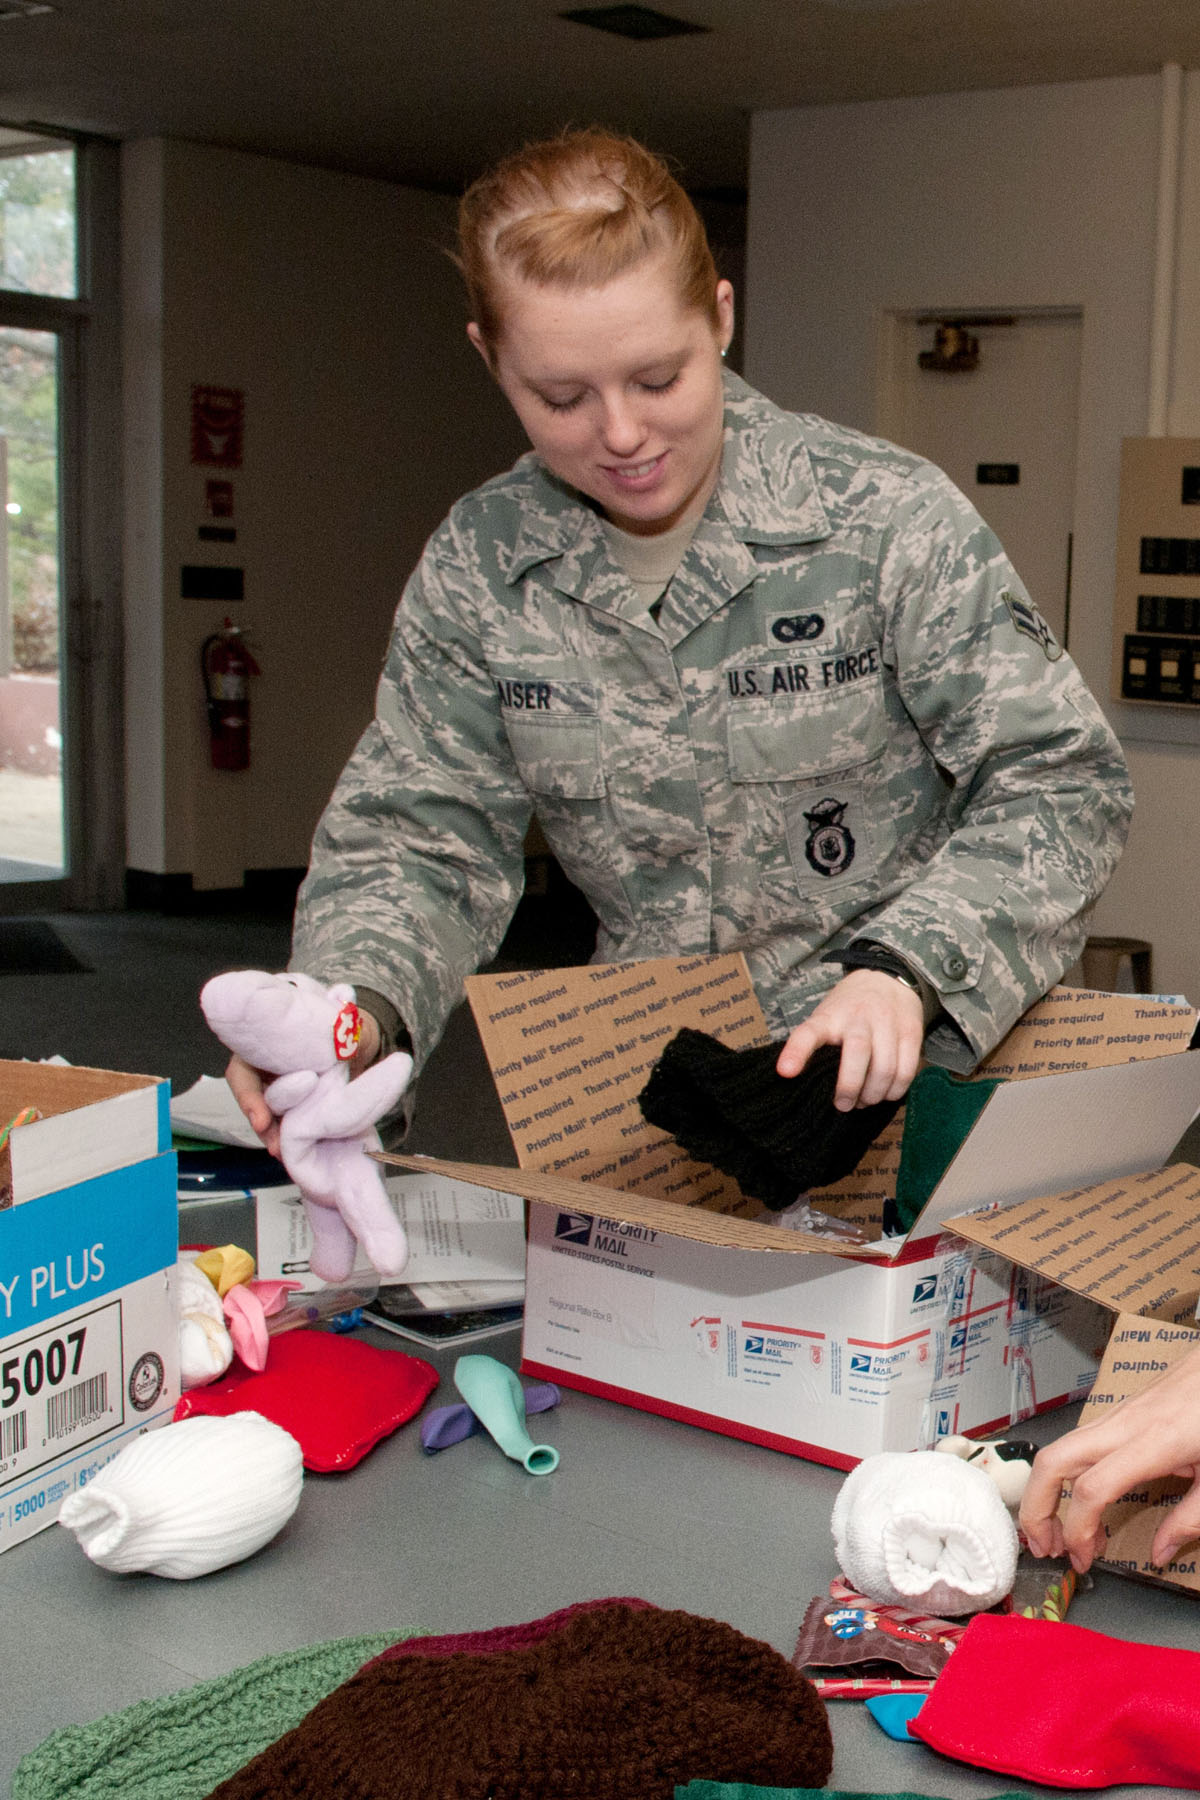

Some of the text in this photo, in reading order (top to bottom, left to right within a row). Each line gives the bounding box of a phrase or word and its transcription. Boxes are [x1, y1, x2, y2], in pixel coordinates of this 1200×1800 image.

[728, 648, 879, 697] U.S. AIR FORCE
[589, 962, 636, 983] Thank you
[676, 956, 704, 975] Thank
[496, 974, 527, 991] Thank
[488, 985, 569, 1024] postage required
[521, 1017, 557, 1038] Priority
[583, 994, 619, 1015] postage
[619, 976, 657, 998] required
[613, 1008, 647, 1028] Priority
[672, 985, 705, 1005] postage
[705, 969, 740, 990] required
[1076, 991, 1096, 1002] you
[700, 1001, 731, 1018] Priority
[1058, 1012, 1105, 1026] required
[1134, 1008, 1192, 1020] Thank you
[724, 1015, 755, 1033] Service
[1033, 1037, 1073, 1049] Priority
[1106, 1033, 1151, 1046] postage
[493, 1061, 523, 1080] riority
[549, 1034, 585, 1055] Service
[519, 1083, 539, 1099] you
[539, 1075, 554, 1090] for
[555, 1065, 582, 1082] using
[581, 1051, 616, 1070] Priority
[640, 1025, 673, 1044] Service
[976, 1063, 1015, 1076] Priority
[1047, 1060, 1088, 1071] Service
[583, 1064, 645, 1097] Thank you for
[534, 1096, 575, 1121] required
[526, 1132, 564, 1154] Priority
[590, 1102, 625, 1125] postage
[553, 1148, 591, 1172] Service
[581, 1162, 618, 1183] Priority
[643, 1164, 669, 1181] using
[664, 1169, 712, 1195] Thank you
[856, 1166, 889, 1178] you for
[808, 1190, 886, 1204] postage required
[598, 1218, 659, 1243] PRIORITY
[594, 1235, 628, 1257] MAIL
[31, 1242, 105, 1308] PLUS
[577, 1250, 601, 1265] STATES
[601, 1257, 625, 1271] POSTAL
[627, 1264, 656, 1279] SERVICE
[1148, 1287, 1179, 1311] Service
[1155, 1328, 1200, 1343] riority
[2, 1327, 87, 1409] 5007
[1112, 1359, 1169, 1374] equired
[1087, 1393, 1114, 1405] usin
[14, 1490, 46, 1522] 5000
[1168, 1560, 1196, 1574] you
